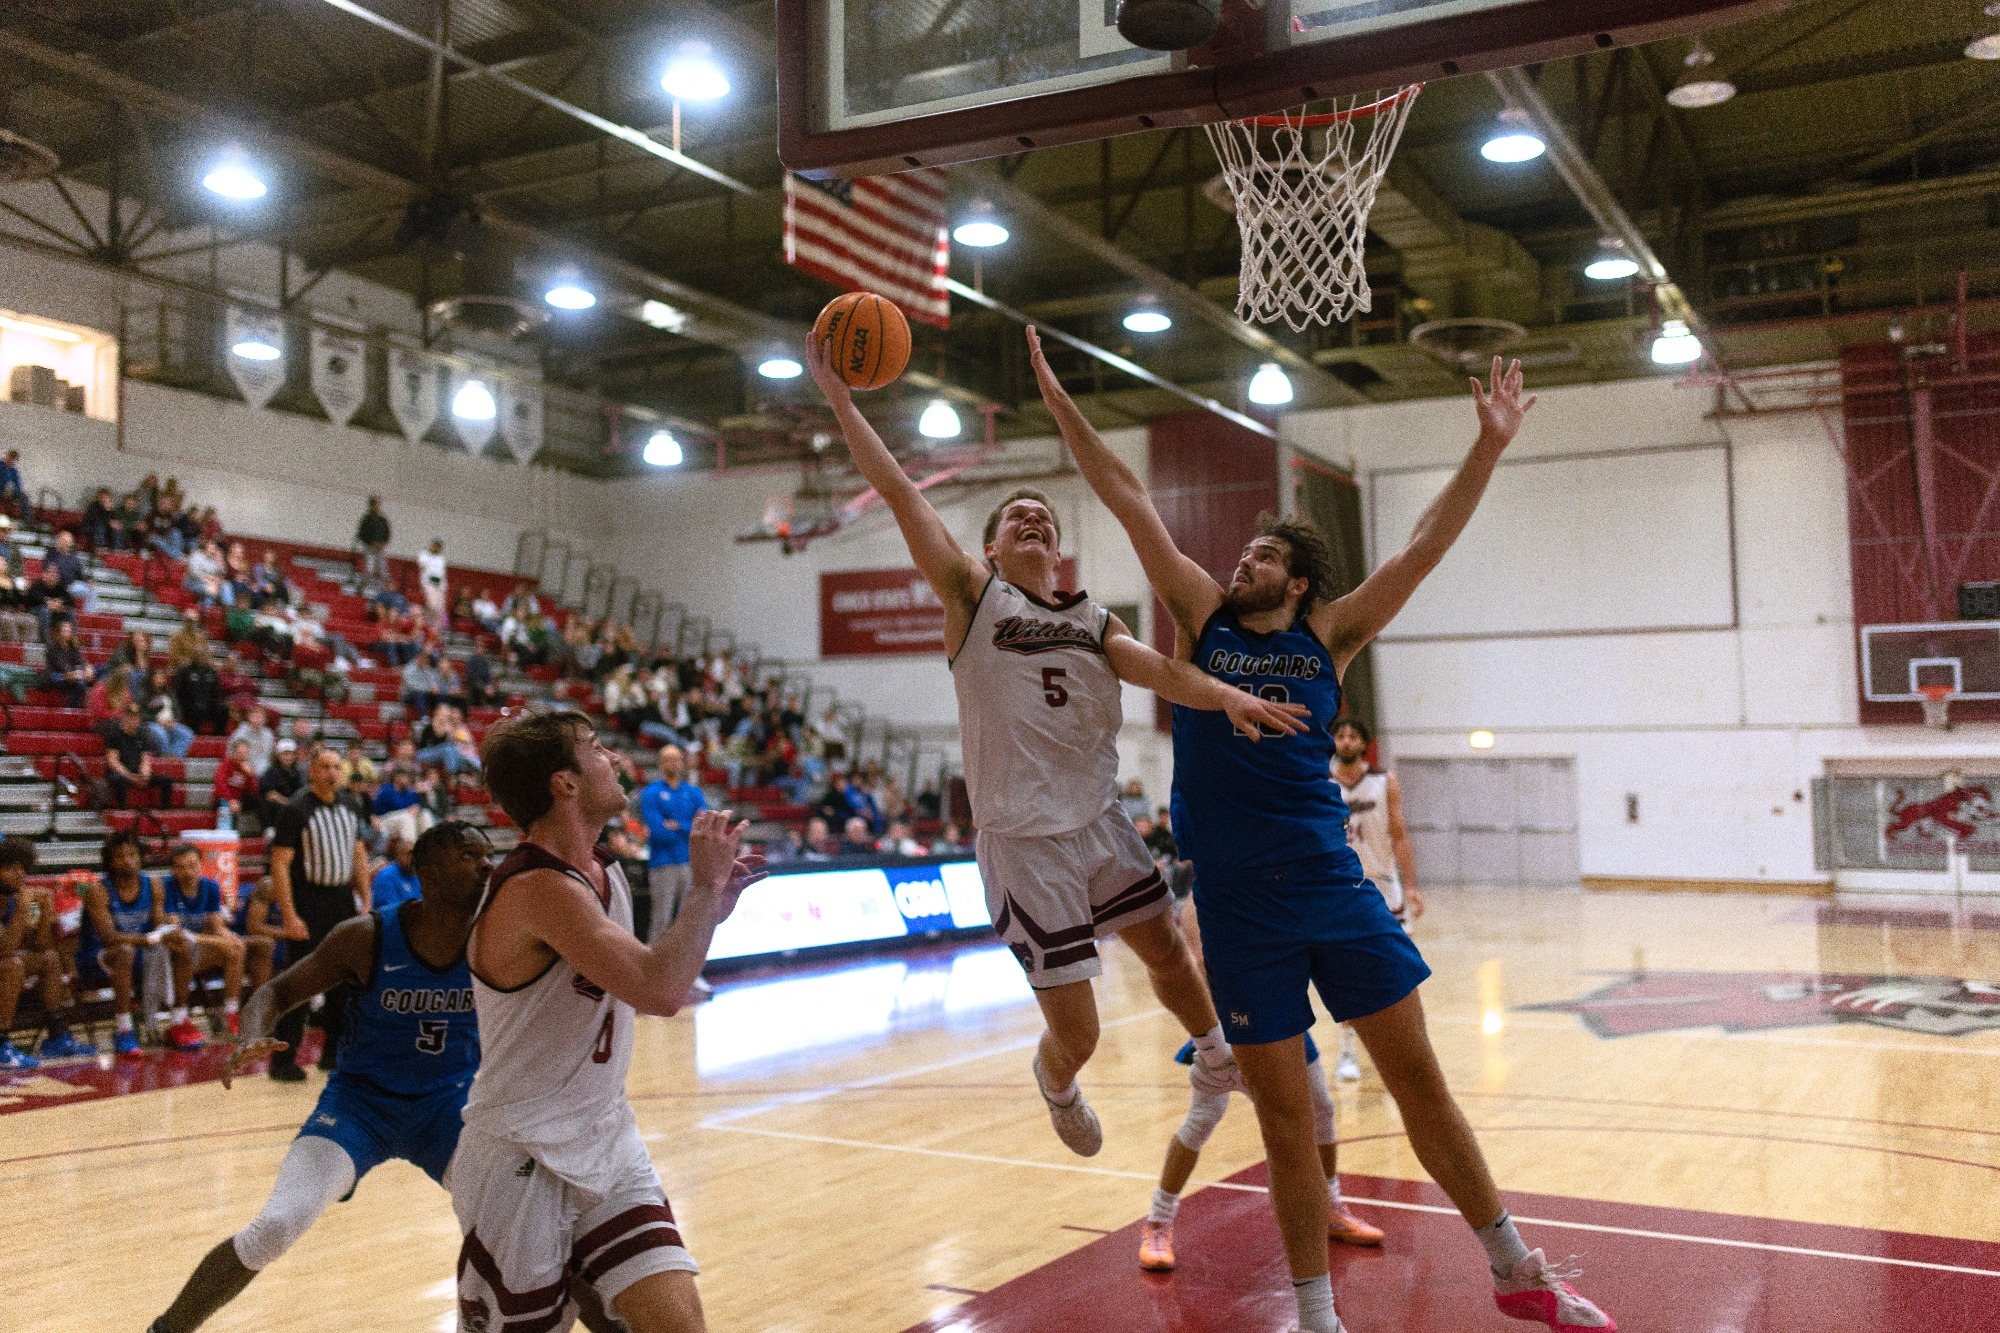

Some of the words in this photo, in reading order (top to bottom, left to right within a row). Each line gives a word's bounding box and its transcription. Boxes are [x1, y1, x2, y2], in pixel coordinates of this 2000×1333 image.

[849, 328, 870, 374] NCAA
[992, 615, 1099, 649] Wildca
[1208, 648, 1320, 680] COUGARS
[1041, 667, 1068, 708] 5
[1230, 1011, 1250, 1027] SM
[415, 1019, 449, 1055] 5
